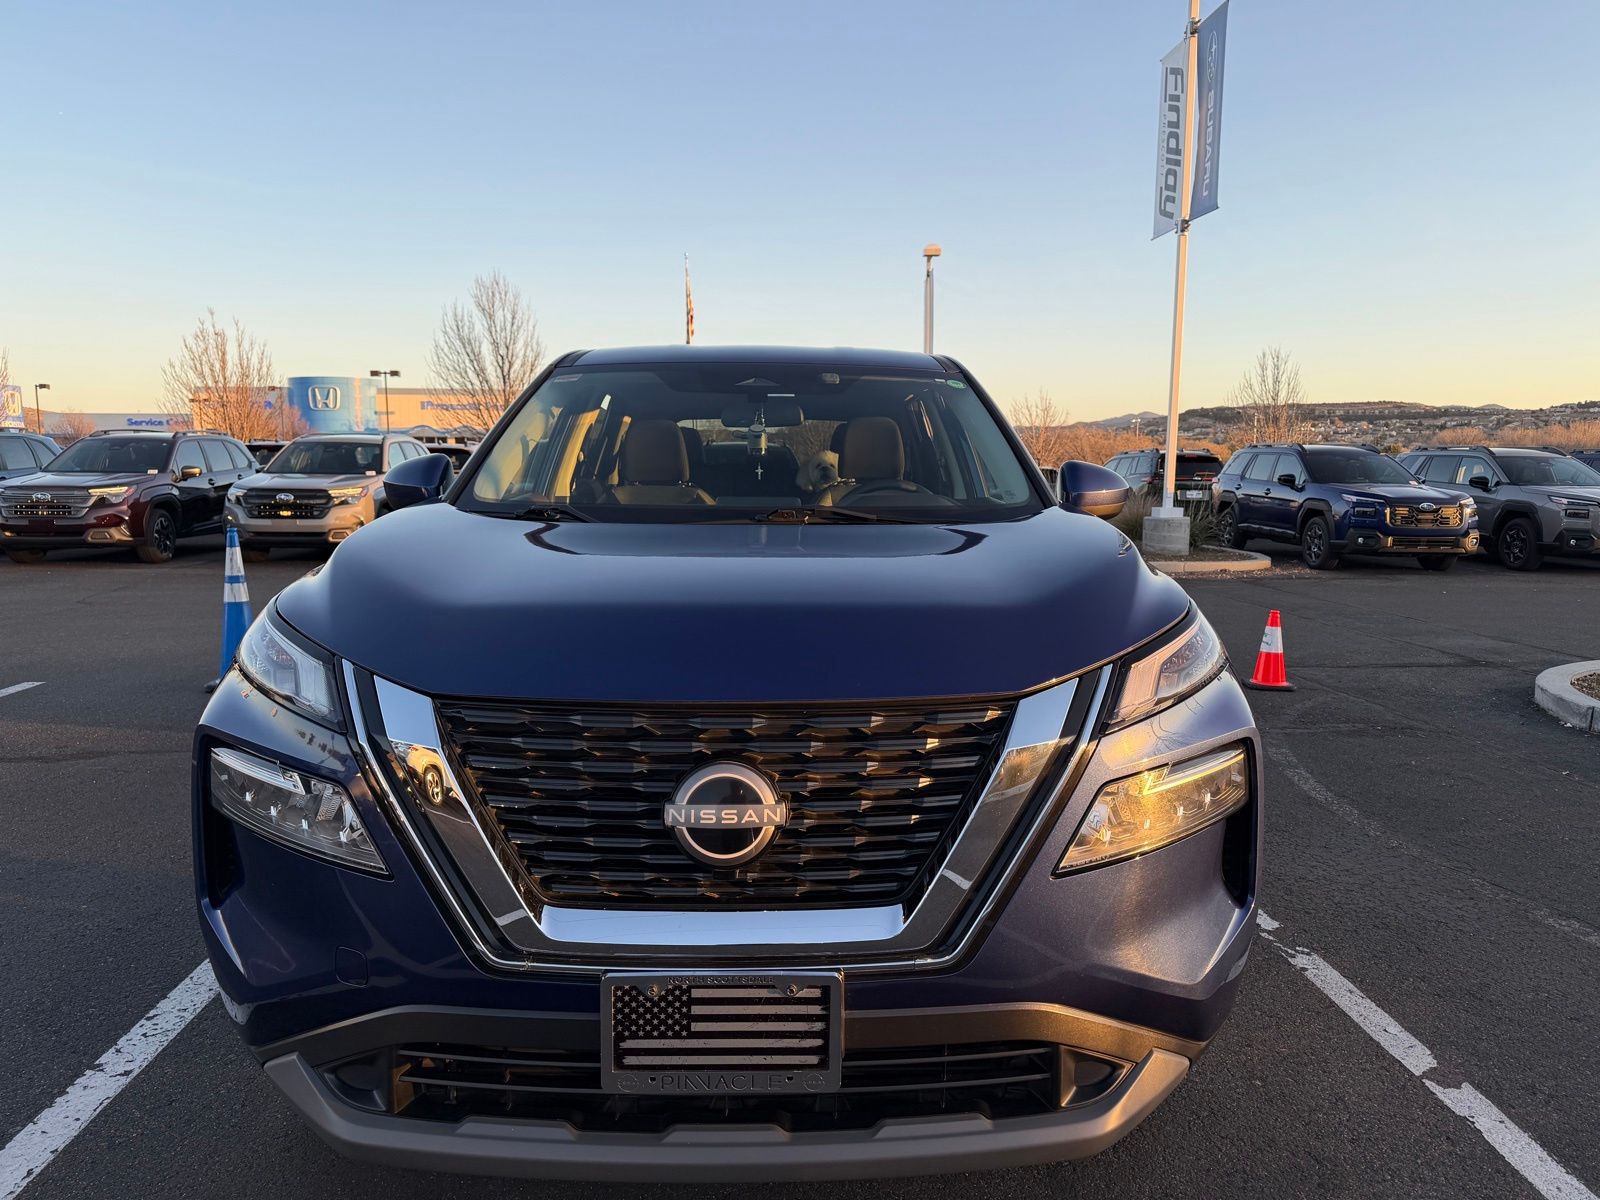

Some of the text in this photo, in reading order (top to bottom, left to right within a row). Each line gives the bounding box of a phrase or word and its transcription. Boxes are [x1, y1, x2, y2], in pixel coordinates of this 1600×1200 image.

[1159, 67, 1184, 220] Findlay
[1202, 90, 1215, 197] SUBARU
[127, 417, 165, 426] Service
[668, 808, 781, 824] NISSAN
[667, 975, 774, 985] NORTH SCOTTSDALE
[661, 1074, 782, 1091] PINNACLE
